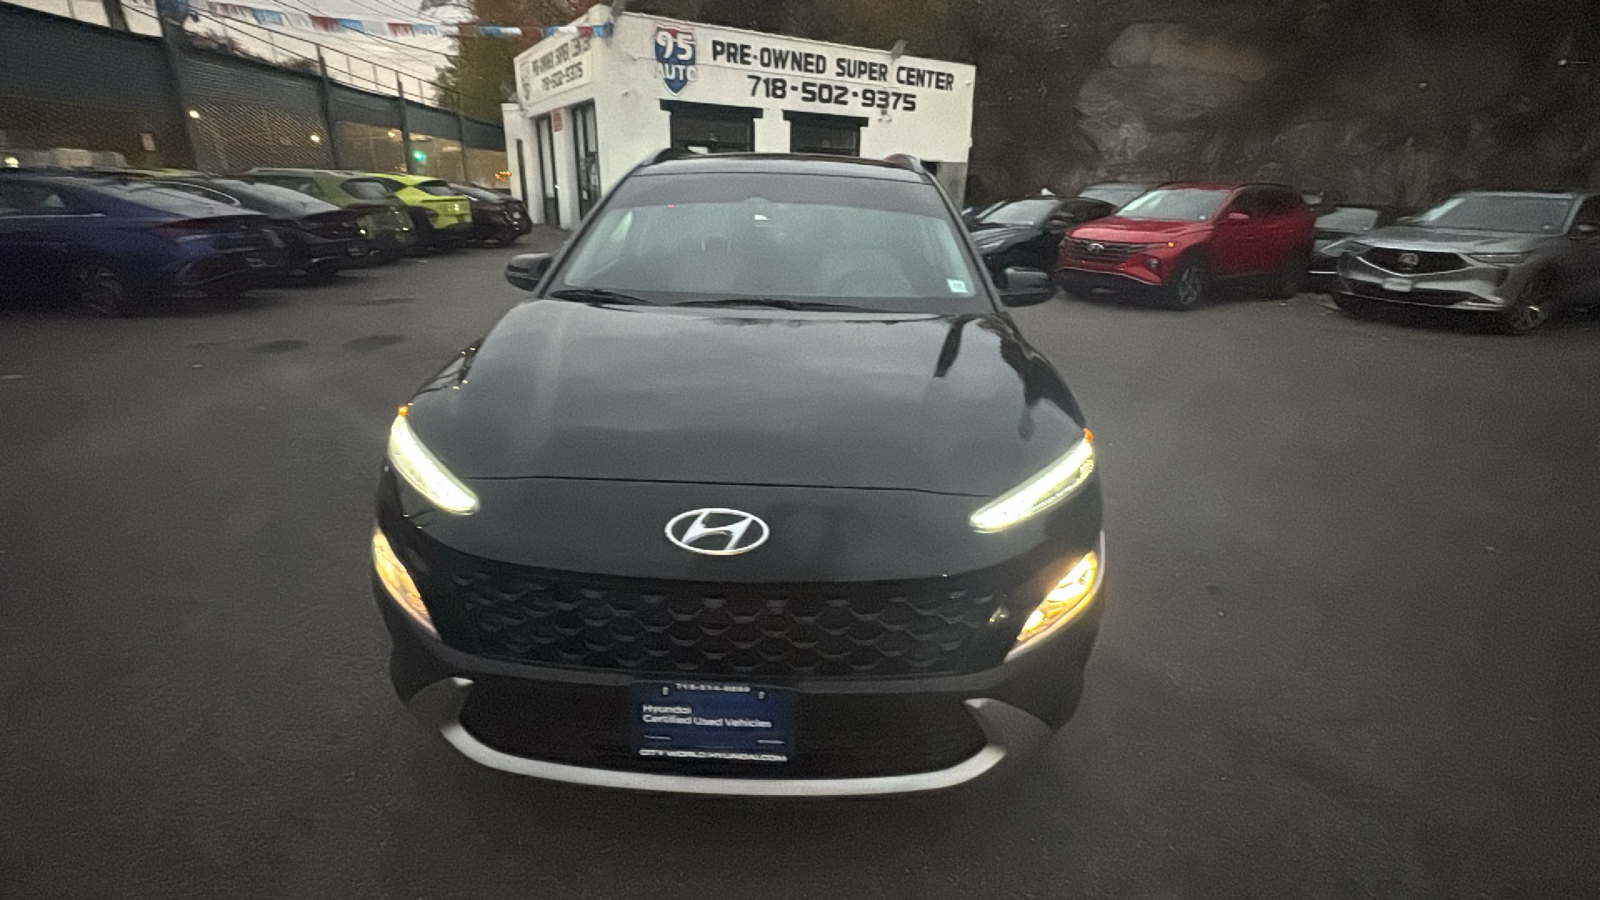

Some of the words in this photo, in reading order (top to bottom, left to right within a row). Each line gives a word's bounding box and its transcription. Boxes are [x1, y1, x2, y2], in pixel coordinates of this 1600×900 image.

[656, 30, 694, 61] 95
[653, 63, 699, 83] AUTO
[712, 40, 827, 75] PRE-OWNED
[835, 57, 889, 83] SUPER
[896, 66, 955, 91] CENTER
[747, 75, 918, 112] 718-502-9375
[642, 704, 692, 714] Hyundai
[642, 714, 693, 725] Certified
[693, 717, 724, 727] Used
[724, 718, 773, 728] Vehicles
